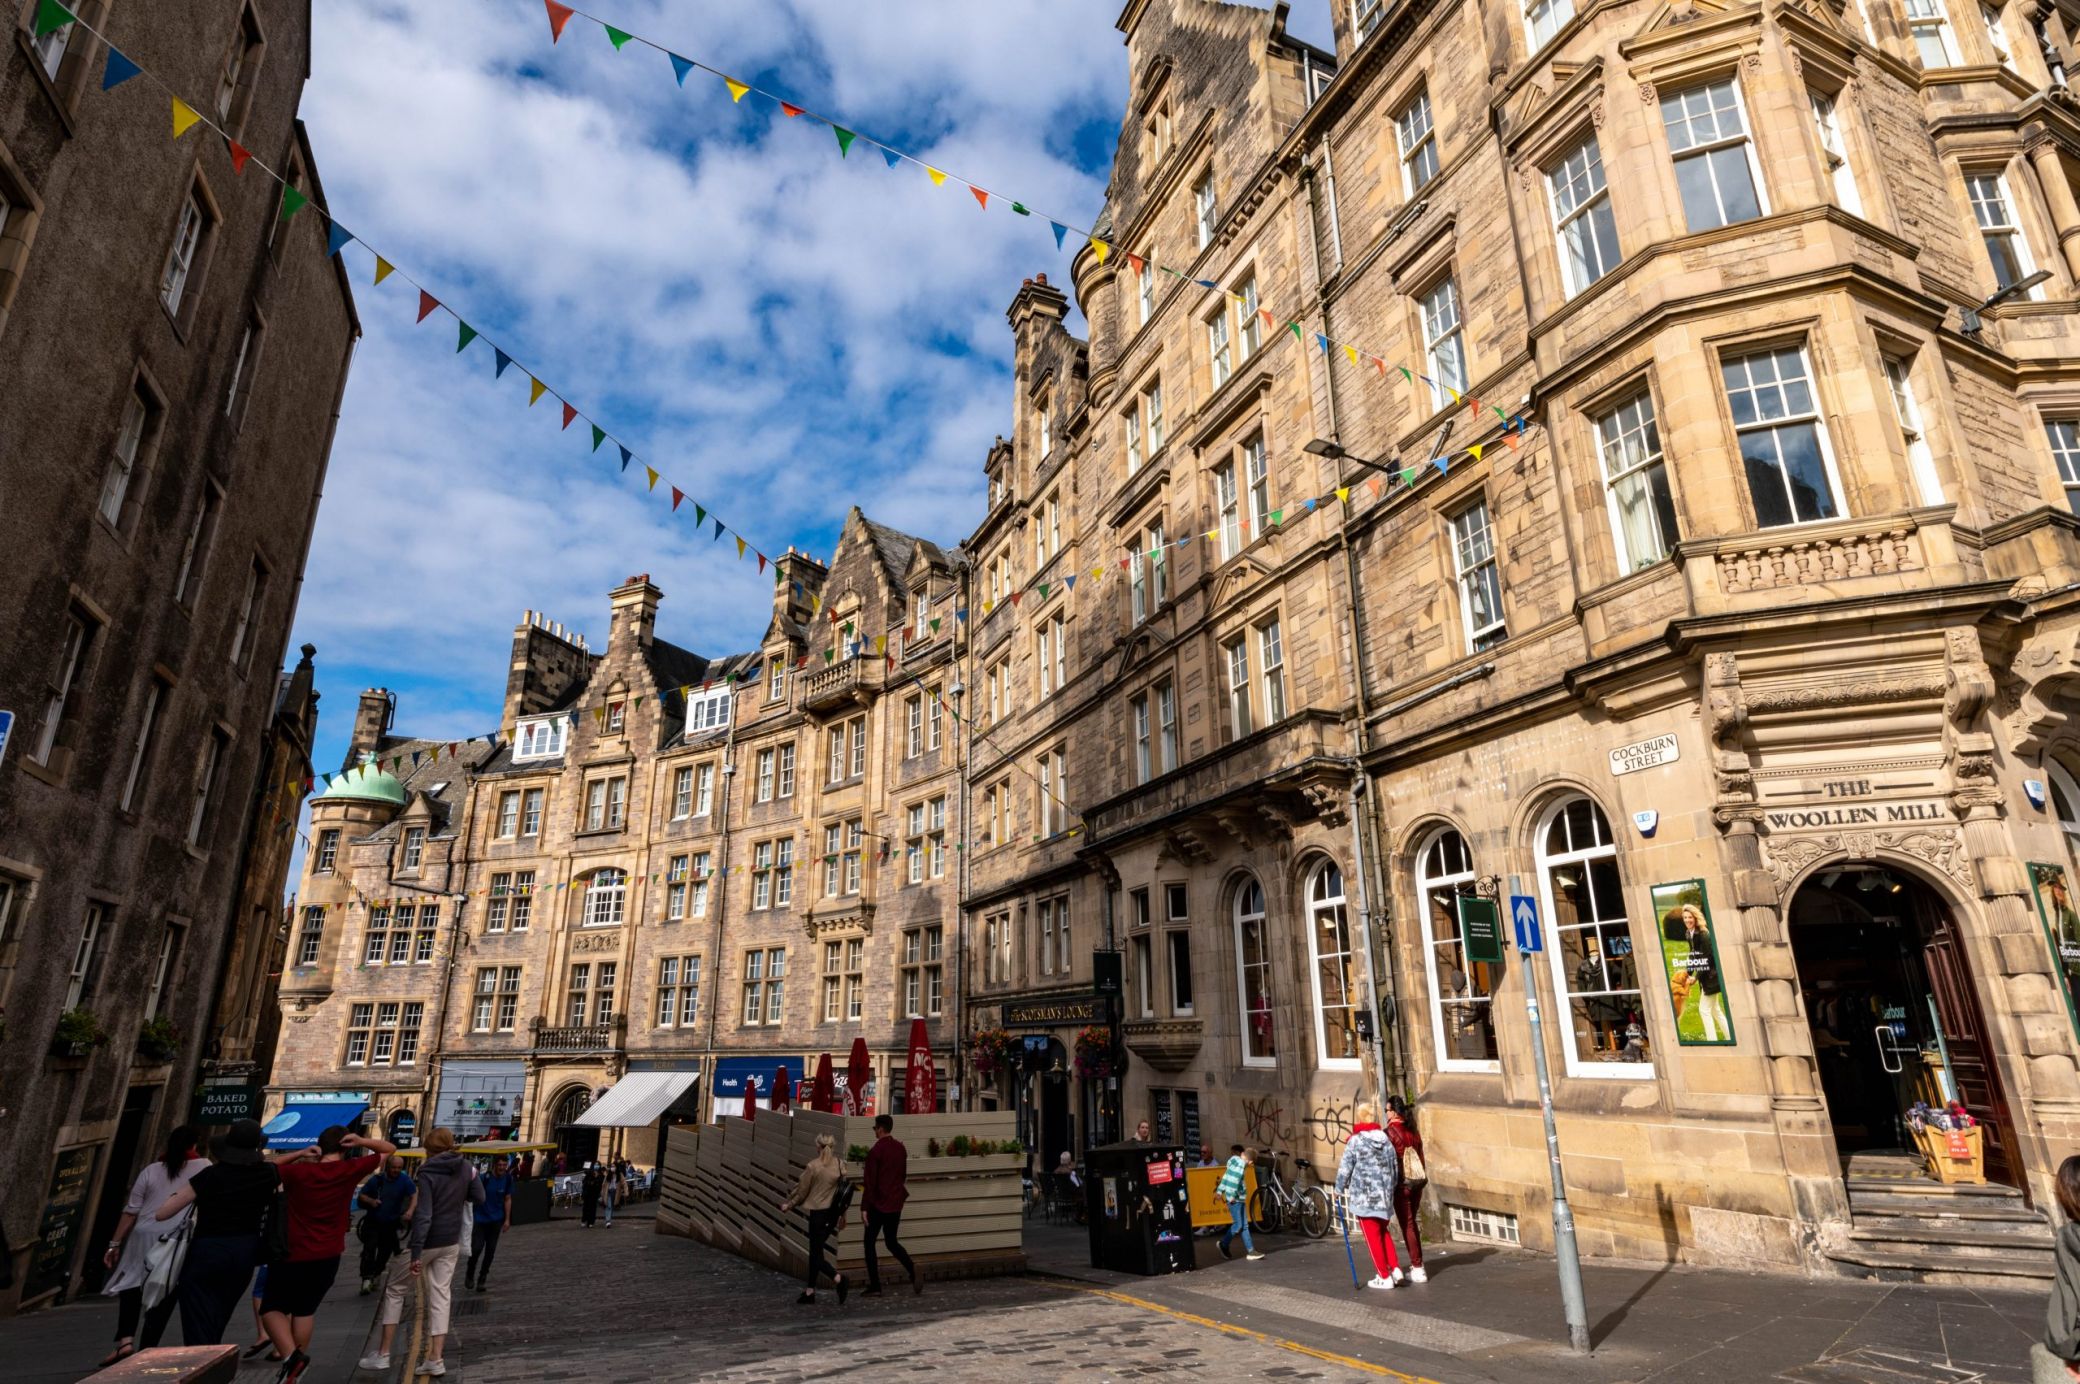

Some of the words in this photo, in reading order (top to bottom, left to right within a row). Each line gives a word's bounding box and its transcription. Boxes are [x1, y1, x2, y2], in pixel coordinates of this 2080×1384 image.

[1612, 735, 1675, 762] COCKBURN
[1624, 751, 1664, 771] STREET
[1824, 780, 1872, 797] THE
[1768, 806, 1878, 829] WOOLLEN
[1886, 803, 1945, 821] MILL
[2059, 945, 2080, 957] Barbou
[1672, 956, 1709, 967] Barbour
[1021, 1006, 1061, 1021] SCOTSMAN'S
[1062, 1004, 1093, 1019] LOUNGE
[722, 1078, 738, 1087] Health
[207, 1094, 247, 1103] BAKED
[201, 1105, 248, 1115] POTATO
[1158, 1111, 1172, 1123] OPE
